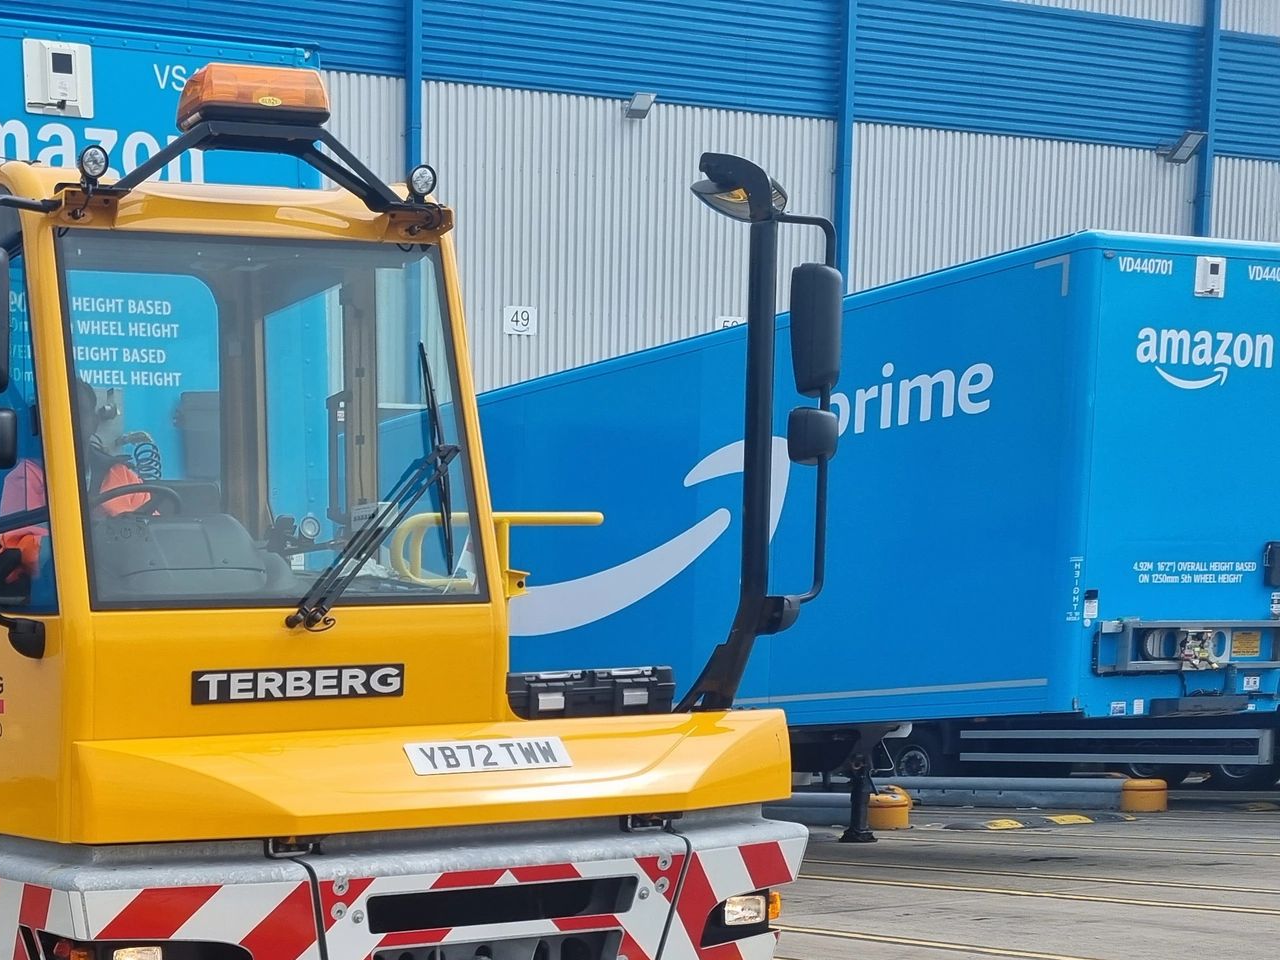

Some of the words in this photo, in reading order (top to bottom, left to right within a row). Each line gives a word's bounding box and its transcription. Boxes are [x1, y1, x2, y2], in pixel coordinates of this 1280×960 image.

[1119, 256, 1173, 275] VD440701
[72, 296, 124, 314] HEIGHT
[127, 299, 172, 316] BASED
[510, 309, 530, 327] 49
[76, 319, 125, 338] WHEEL
[128, 322, 179, 338] HEIGHT
[122, 348, 166, 364] BASED
[1136, 327, 1274, 368] amazon
[79, 369, 128, 386] WHEEL
[130, 372, 182, 387] HEIGHT
[1177, 561, 1208, 572] OVERALL
[1209, 561, 1234, 572] HEIGHT
[1235, 561, 1257, 572] BASED
[1138, 573, 1150, 584] ON
[1151, 573, 1180, 584] 1250mm
[1180, 573, 1192, 584] 5th
[1193, 573, 1217, 584] WHEEL
[1217, 573, 1243, 584] HEIGHT
[198, 667, 402, 701] TERBERG
[419, 744, 498, 770] YB72
[499, 740, 558, 766] TWW
